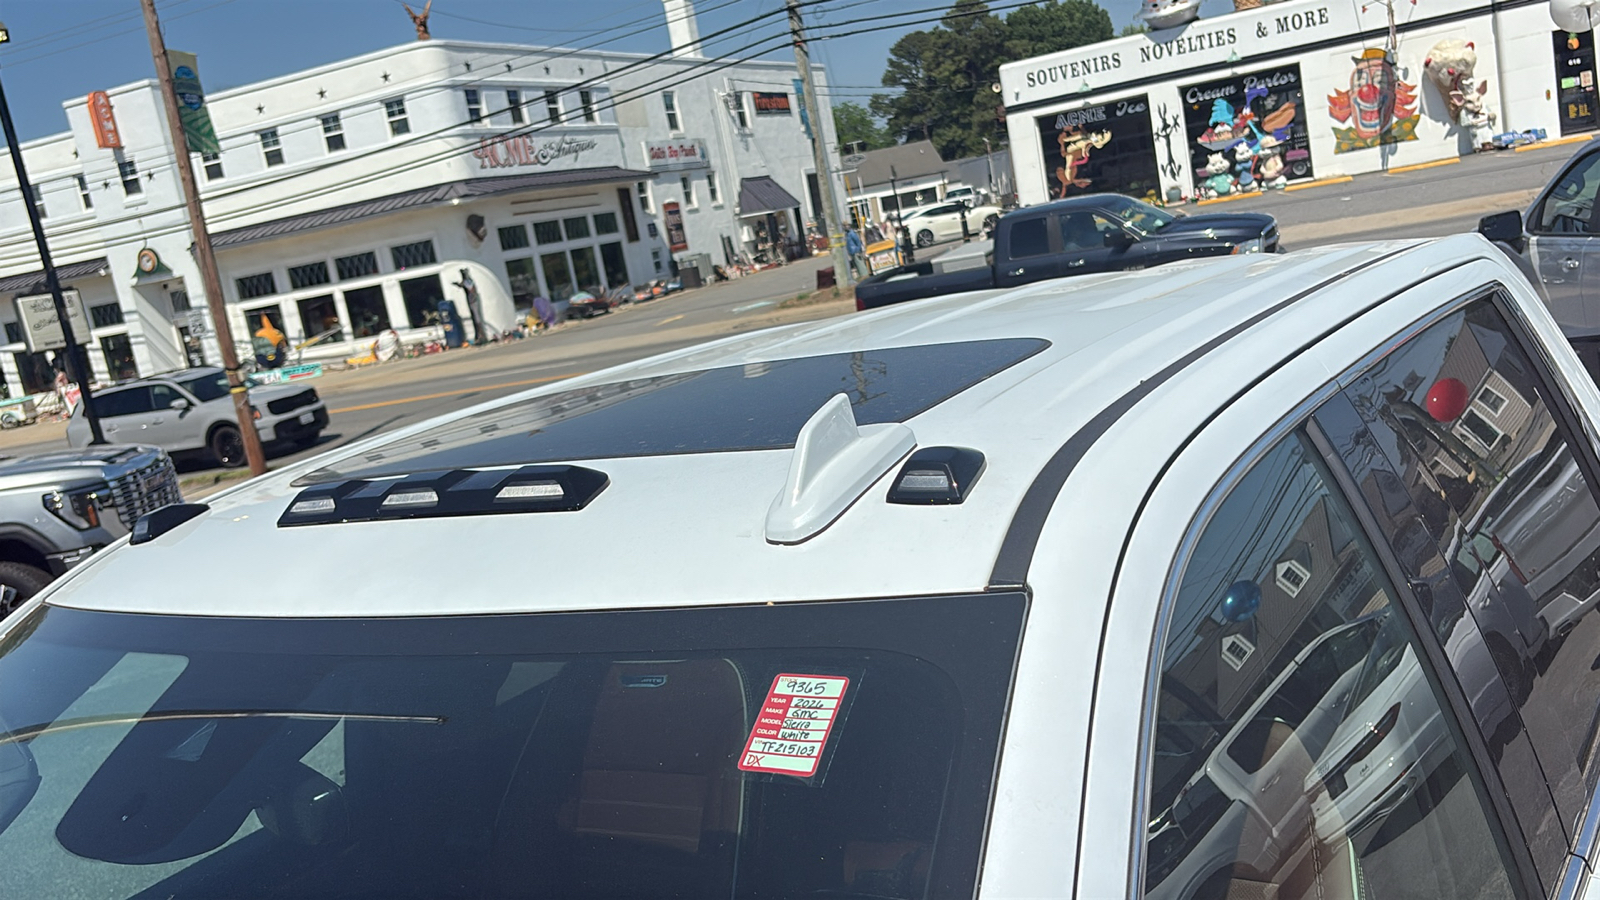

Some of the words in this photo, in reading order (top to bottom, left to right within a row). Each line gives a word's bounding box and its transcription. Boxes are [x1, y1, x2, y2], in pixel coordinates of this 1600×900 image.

[1026, 53, 1121, 88] SOUVENIRS
[1140, 28, 1237, 63] NOVELTIES
[1256, 21, 1268, 39] &
[1275, 7, 1329, 34] MORE
[1186, 84, 1237, 104] Cream
[1243, 71, 1297, 93] Parlor
[1055, 105, 1107, 130] ACME
[1115, 101, 1147, 117] Ice
[472, 134, 538, 169] ACME
[786, 681, 827, 695] 9365
[794, 698, 824, 709] 2026
[761, 717, 782, 725] MODEL
[782, 719, 811, 729] Sierra
[756, 728, 777, 736] COLOR
[761, 741, 815, 756] TF215103
[746, 754, 765, 766] DX
